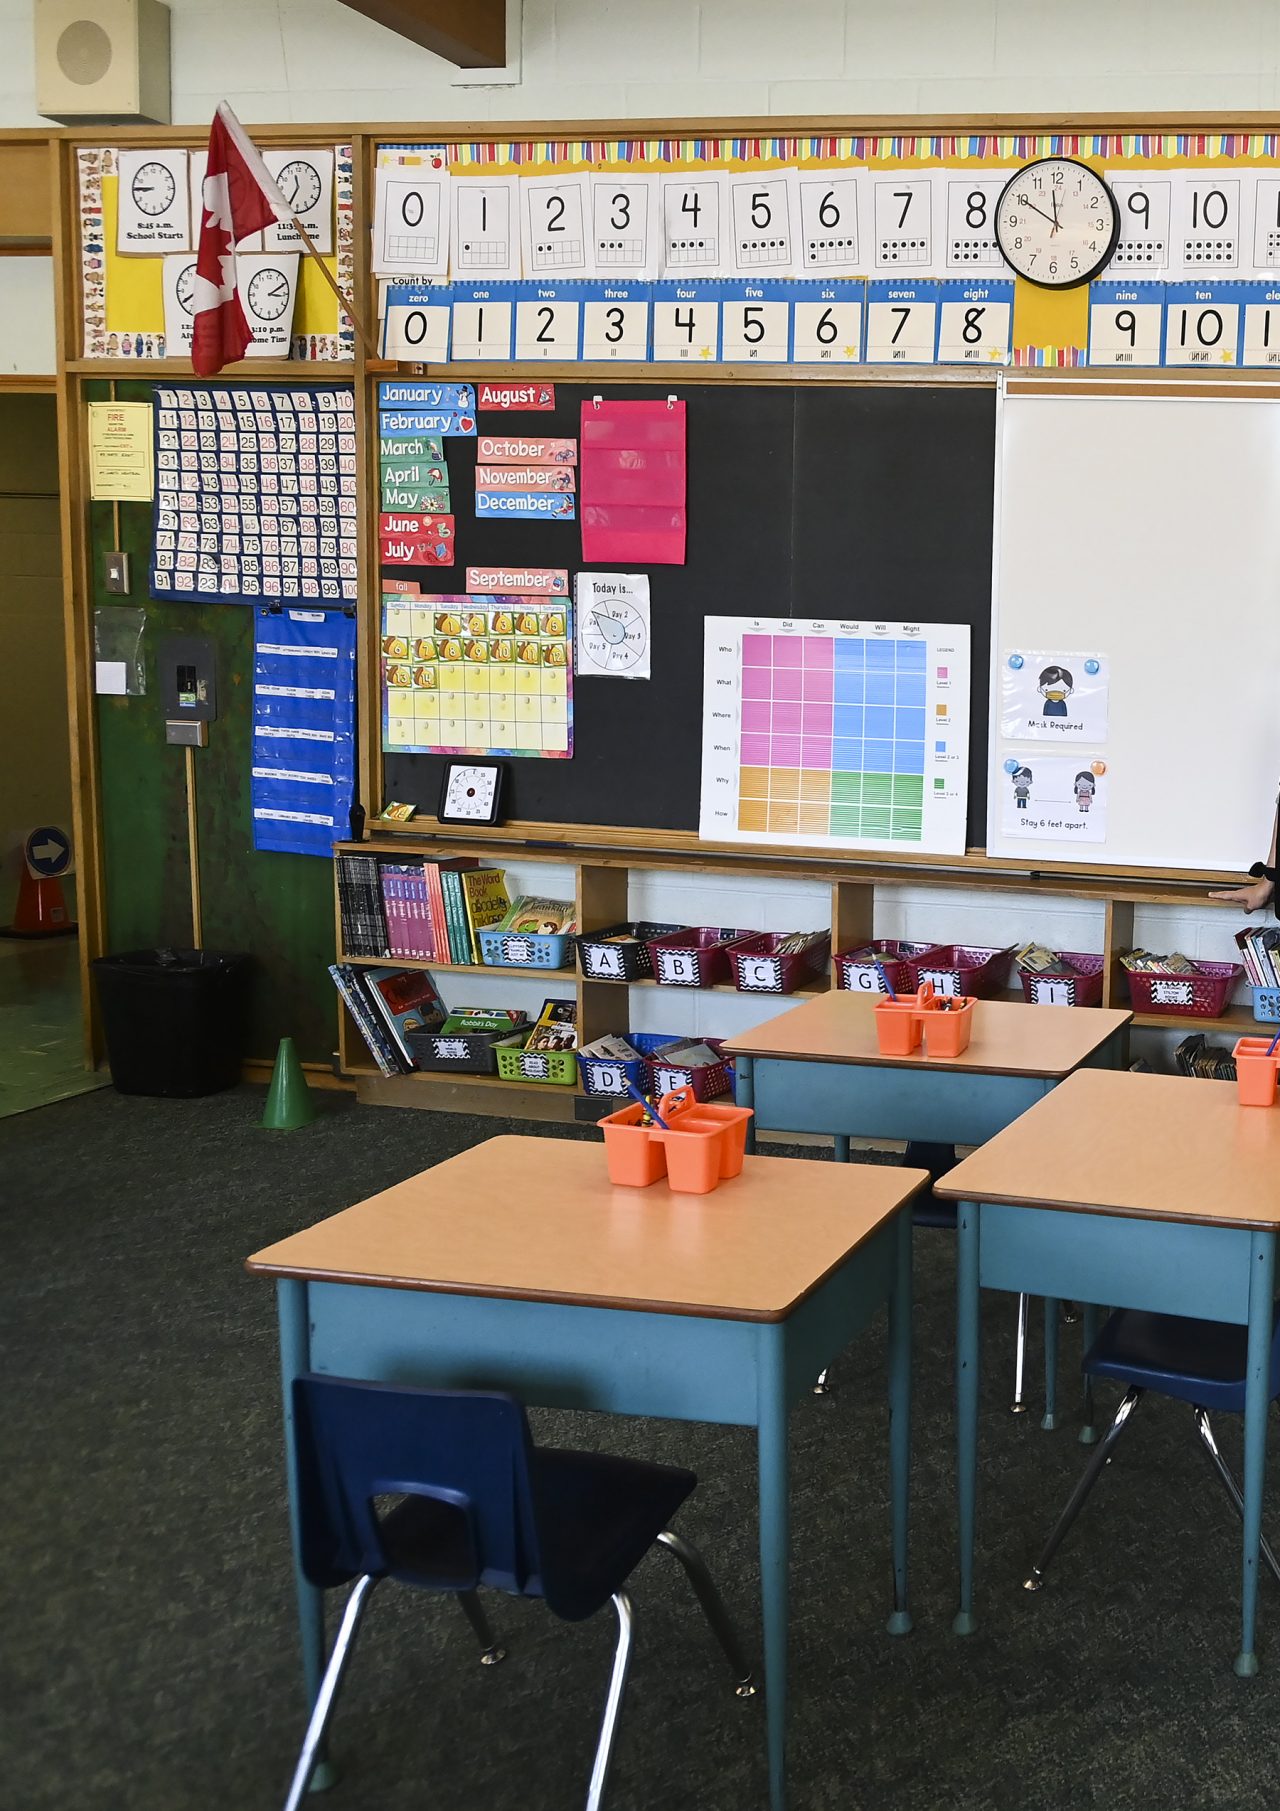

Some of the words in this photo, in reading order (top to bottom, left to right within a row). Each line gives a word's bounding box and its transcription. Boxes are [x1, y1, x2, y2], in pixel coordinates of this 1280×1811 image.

[1051, 172, 1063, 184] 12
[402, 192, 423, 226] 0
[820, 192, 839, 227] 6
[1009, 215, 1017, 227] 9
[1096, 219, 1104, 231] 3
[126, 232, 156, 240] School
[158, 231, 184, 239] Starts
[392, 277, 420, 287] Count
[473, 290, 489, 299] one
[605, 288, 628, 298] three
[745, 288, 763, 298] five
[888, 290, 915, 299] seven
[963, 288, 989, 301] eight
[1115, 290, 1137, 300] nine
[1181, 310, 1222, 345] 10
[271, 335, 288, 343] Time
[382, 385, 442, 405] January
[481, 387, 535, 411] August
[107, 413, 124, 421] FIRE
[200, 411, 214, 427] 13
[383, 413, 452, 435] February
[380, 439, 424, 455] March
[481, 440, 545, 458] October
[301, 457, 315, 470] 38
[384, 466, 420, 488] April
[479, 467, 552, 485] November
[281, 478, 296, 491] 47
[181, 495, 196, 507] 52
[385, 488, 418, 507] May
[477, 493, 554, 512] December
[384, 516, 419, 533] June
[281, 540, 296, 552] 77
[384, 541, 414, 561] July
[395, 582, 408, 591] fall
[469, 571, 550, 592] September
[323, 583, 337, 595] 99
[592, 583, 616, 595] Today
[903, 625, 920, 634] Might
[449, 647, 456, 656] 8
[551, 652, 562, 662] 12
[1050, 722, 1083, 732] Required
[716, 777, 729, 785] Why
[1020, 818, 1038, 829] Stay
[1040, 819, 1045, 827] 6
[1047, 820, 1063, 828] feet
[1065, 821, 1089, 831] apart.
[468, 875, 481, 887] The
[481, 872, 500, 884] Word
[470, 887, 487, 898] Book
[531, 901, 569, 914] Franklin
[599, 952, 612, 967] A
[674, 960, 684, 976] B
[754, 965, 765, 982] C
[859, 972, 872, 990] G
[934, 979, 944, 994] H
[485, 1020, 498, 1029] Day
[603, 1073, 613, 1086] D
[669, 1075, 677, 1090] E
